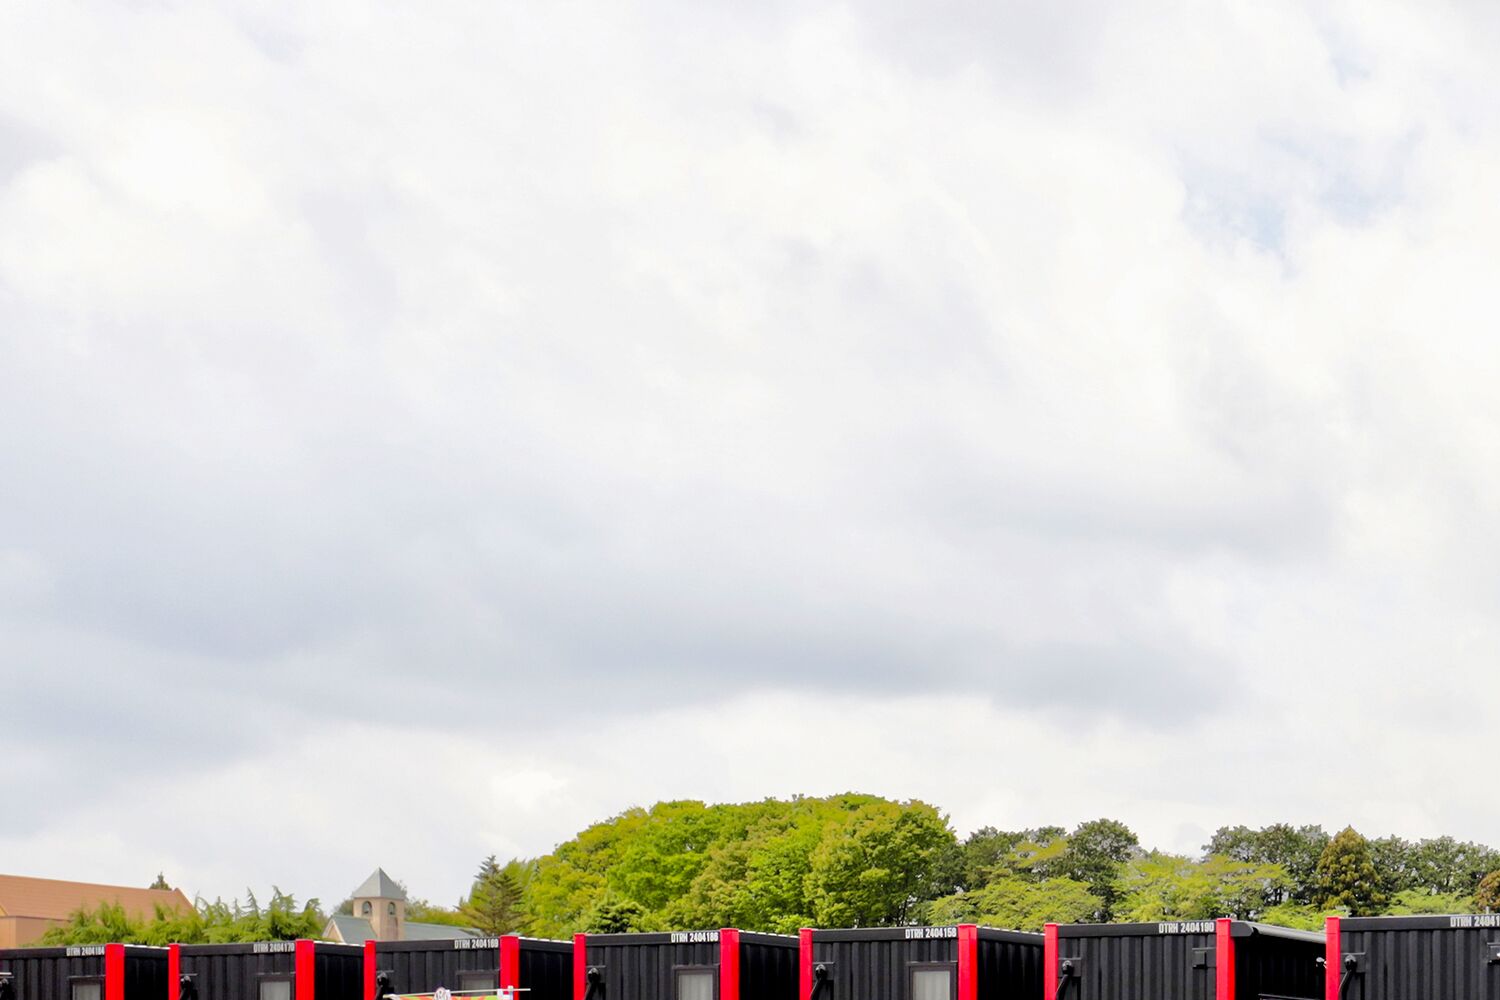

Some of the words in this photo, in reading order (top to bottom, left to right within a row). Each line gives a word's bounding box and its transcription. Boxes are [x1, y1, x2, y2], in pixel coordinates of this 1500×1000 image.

[1450, 916, 1472, 928] DTRH
[905, 928, 923, 939] DTRH
[1158, 923, 1179, 934] DTRH
[670, 932, 688, 943] DTRH
